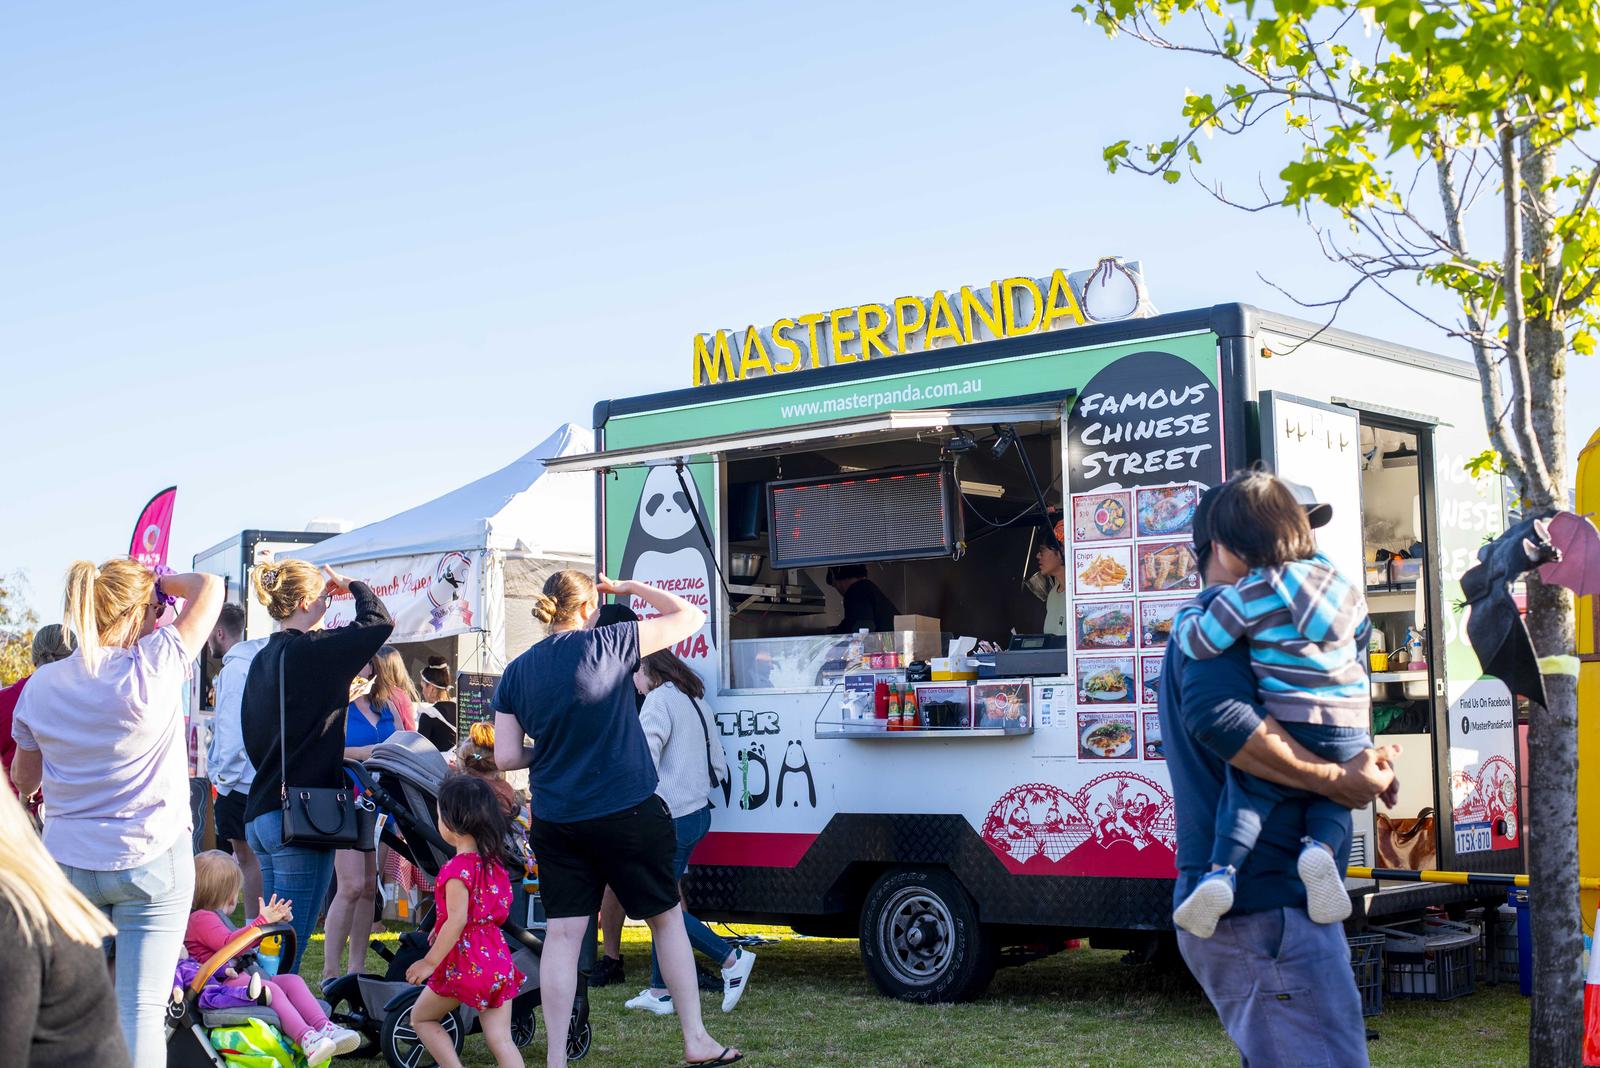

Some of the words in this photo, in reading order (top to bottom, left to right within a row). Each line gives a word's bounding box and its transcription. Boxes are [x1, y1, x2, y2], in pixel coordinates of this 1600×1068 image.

[692, 268, 1086, 387] MASTERPANDA
[781, 378, 982, 419] www.masterpanda.com.au
[1080, 383, 1210, 418] FAMOUS
[1081, 413, 1211, 446] CHINESE
[1081, 444, 1212, 479] STREET
[1076, 553, 1093, 561] Chips
[1076, 561, 1084, 569] $6
[1143, 608, 1157, 618] $12
[1144, 665, 1158, 674] $15
[1460, 698, 1471, 709] Find
[1472, 698, 1479, 708] Us
[1480, 697, 1488, 708] On
[1488, 696, 1511, 707] Facebook
